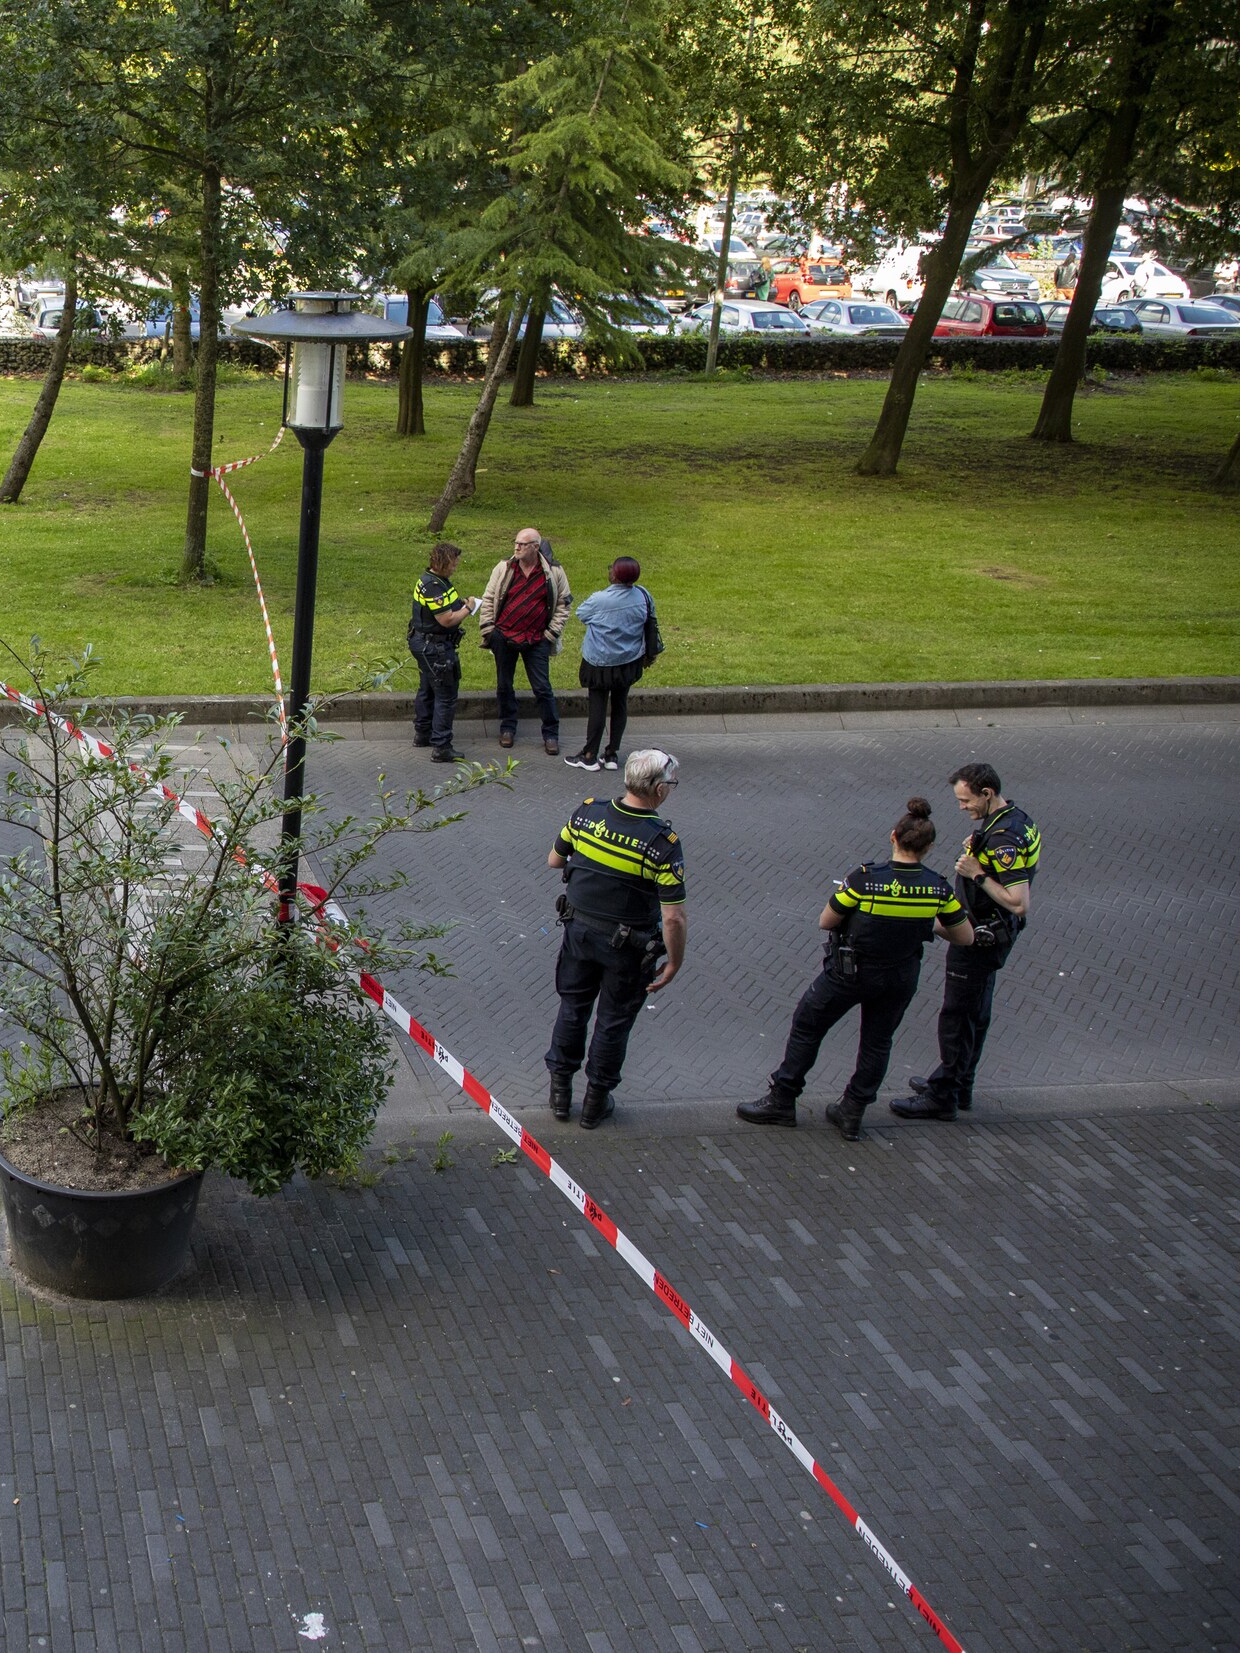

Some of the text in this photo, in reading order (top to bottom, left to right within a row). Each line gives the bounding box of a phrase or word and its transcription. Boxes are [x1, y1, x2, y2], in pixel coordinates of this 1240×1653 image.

[588, 819, 640, 848] POLITIE
[883, 879, 934, 897] POLITIE
[385, 996, 397, 1013] NIET
[420, 1030, 449, 1063] POLITIE
[491, 1099, 539, 1154] NIET BETREDEN
[567, 1179, 603, 1222] POLITIE
[653, 1273, 714, 1348] NIET BETREDEN
[750, 1388, 794, 1447] POLITIE
